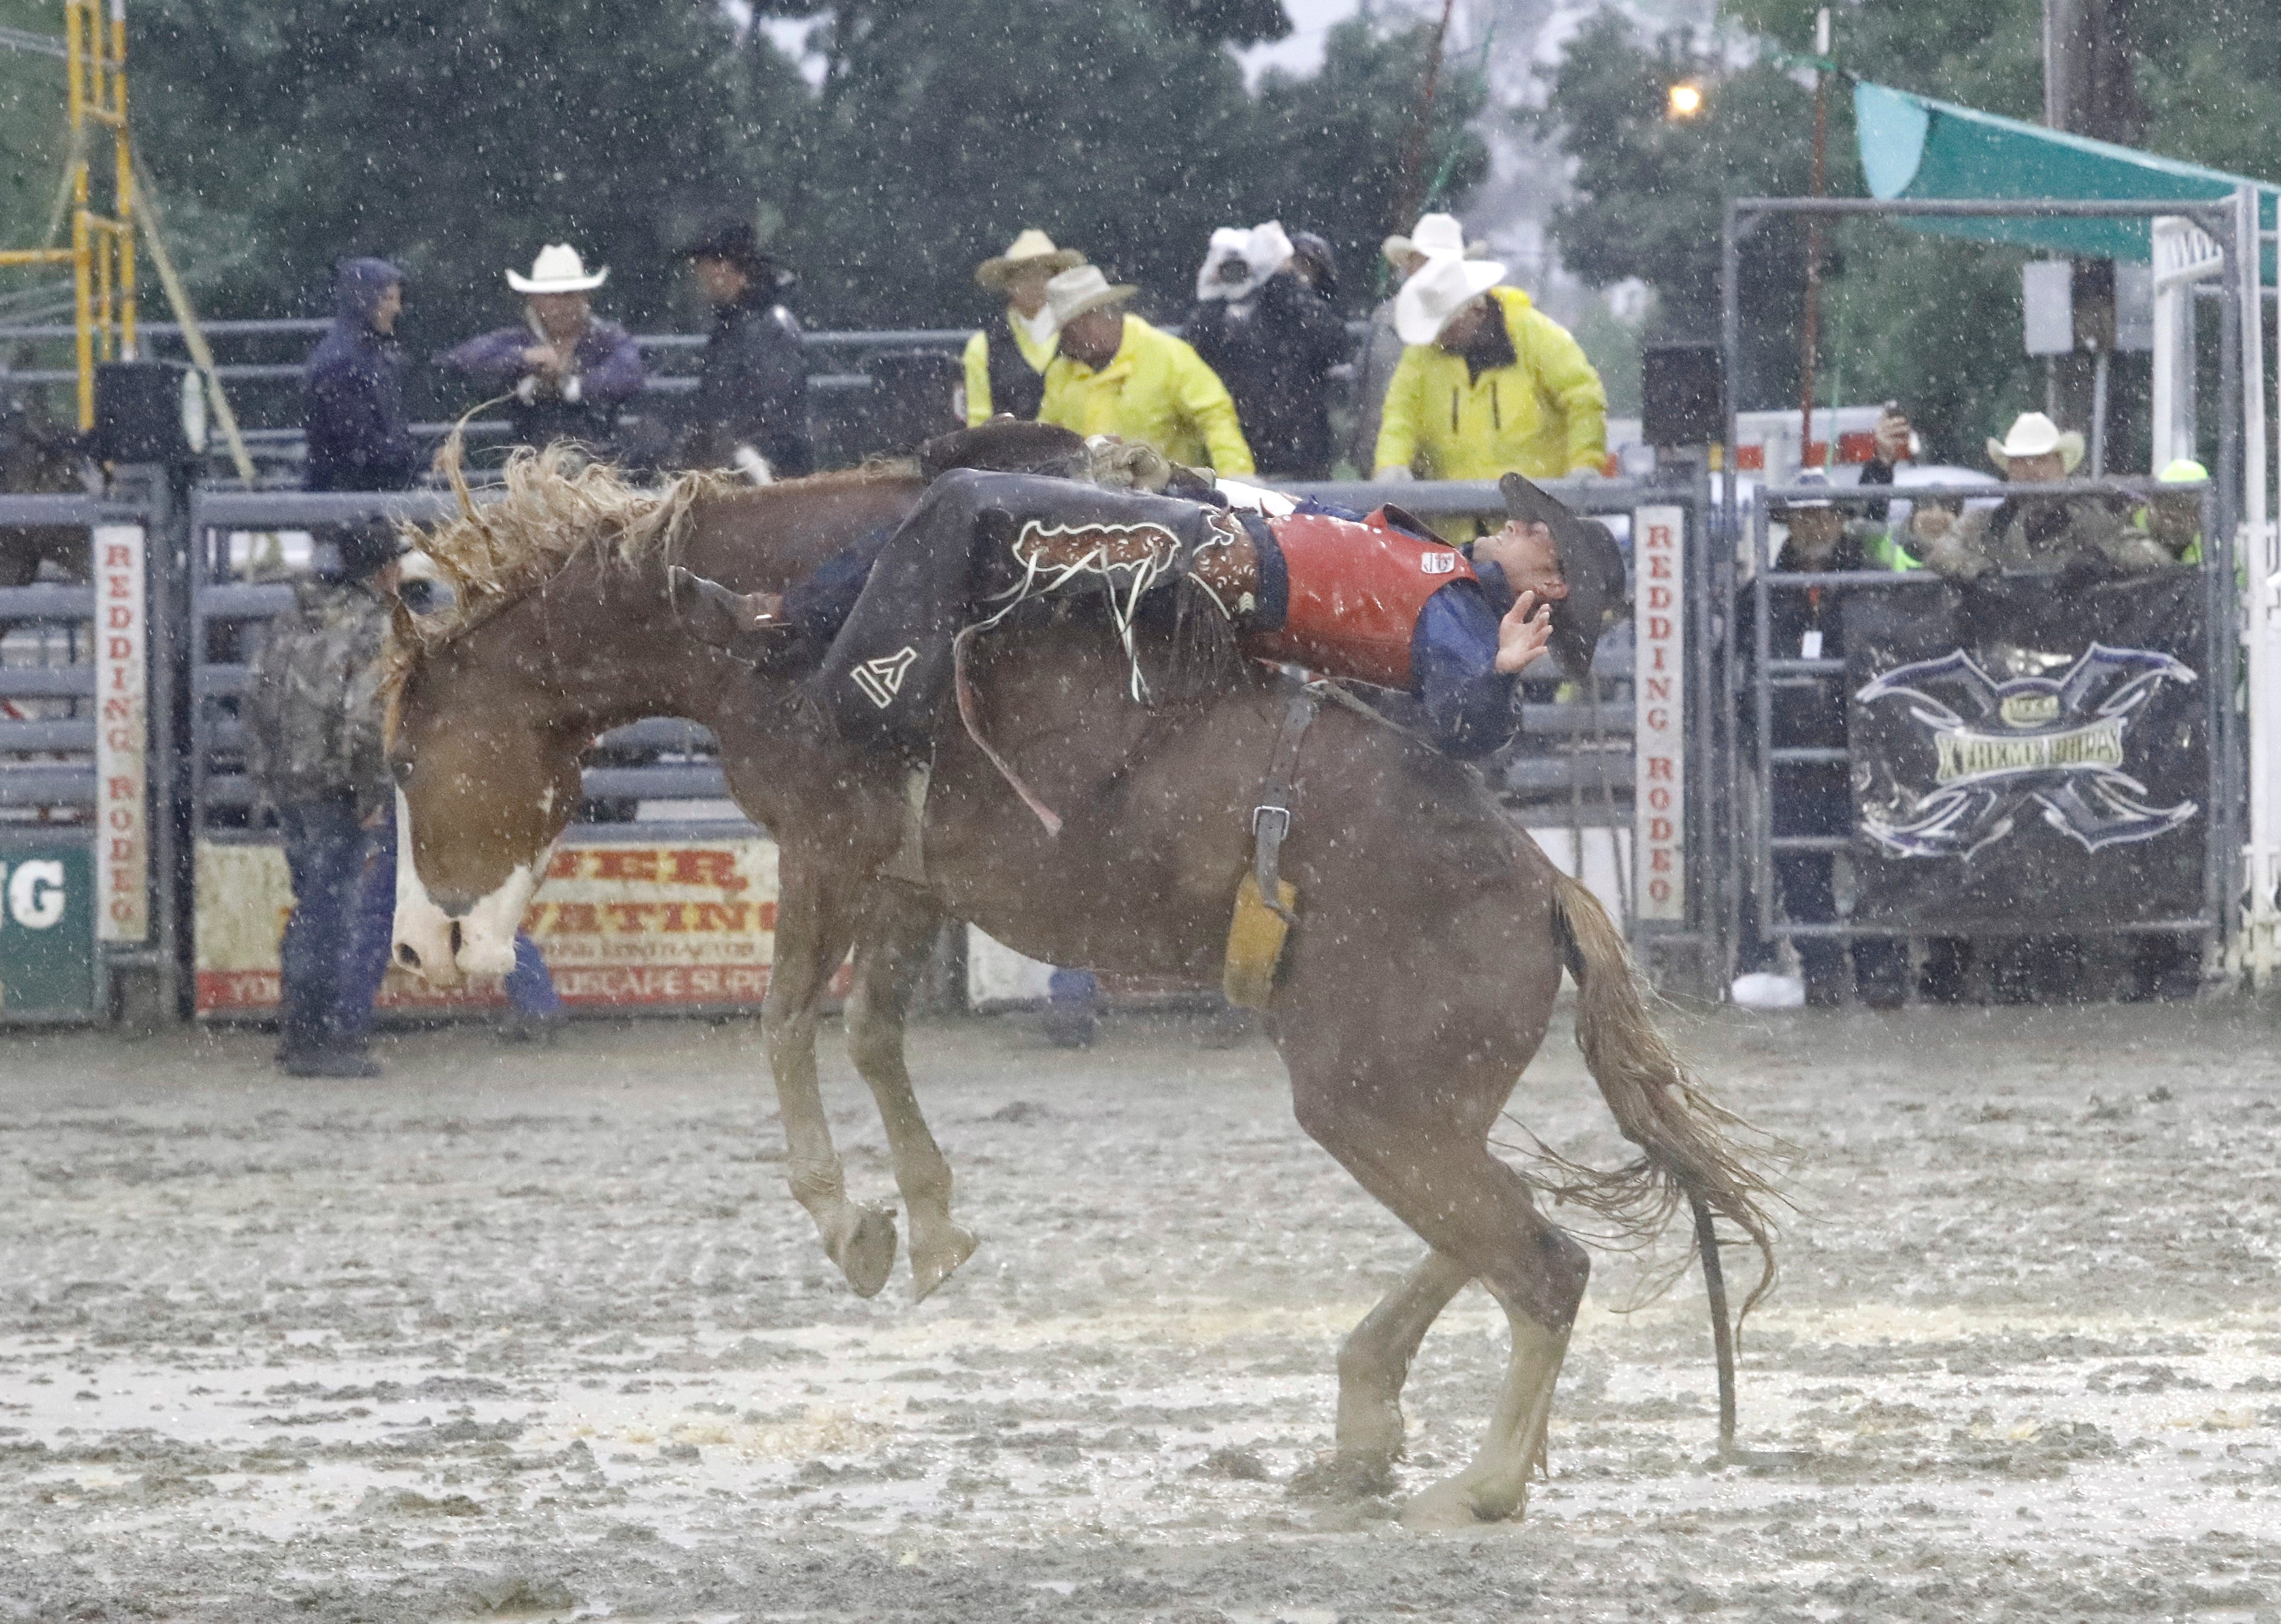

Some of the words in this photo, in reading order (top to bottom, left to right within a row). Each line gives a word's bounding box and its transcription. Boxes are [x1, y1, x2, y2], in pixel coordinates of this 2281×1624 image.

[106, 544, 133, 755] REDDING
[1647, 525, 1673, 731] REDDING
[109, 776, 133, 922] RODEO
[1648, 757, 1673, 902] RODEO
